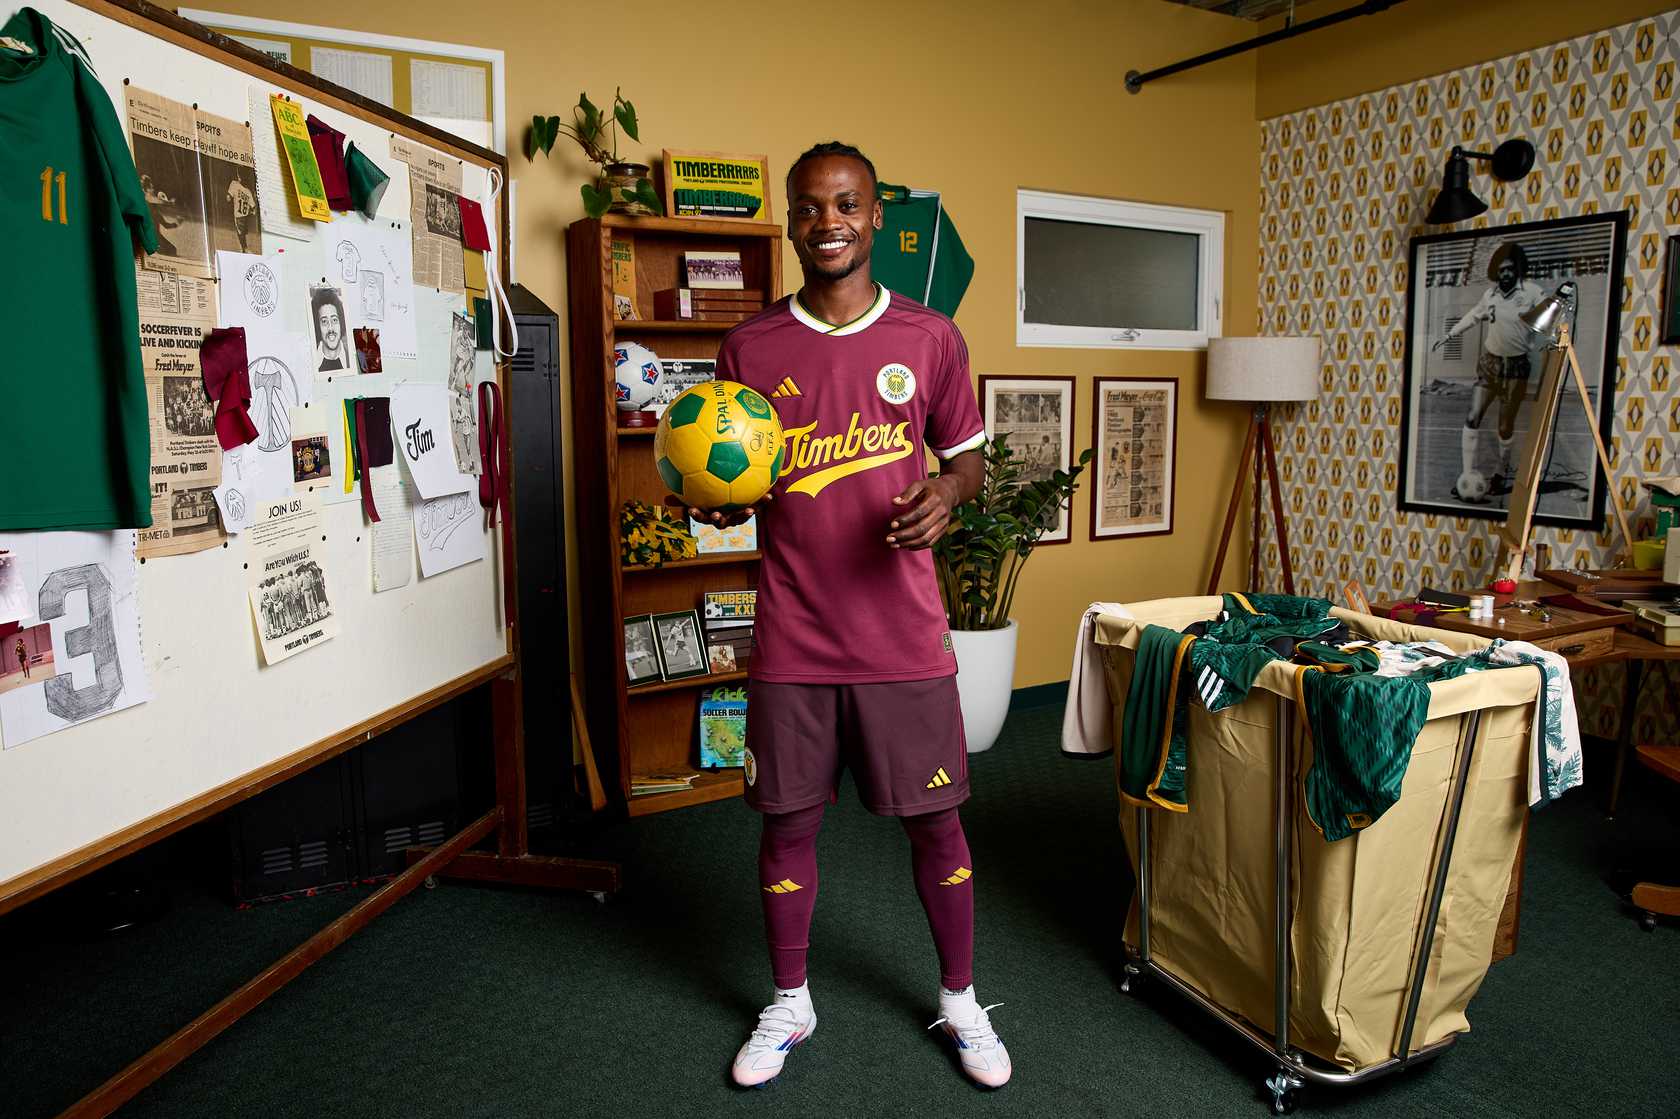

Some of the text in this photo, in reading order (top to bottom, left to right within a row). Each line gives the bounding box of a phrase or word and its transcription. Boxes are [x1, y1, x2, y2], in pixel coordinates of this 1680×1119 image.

[196, 120, 221, 137] SPORTS
[131, 116, 168, 140] Timbers
[169, 128, 191, 147] keep
[218, 144, 239, 160] hope
[240, 153, 255, 165] aliv
[40, 166, 68, 225] 11
[899, 230, 919, 253] 12
[141, 323, 202, 337] SOCCERFEVER IS
[140, 337, 201, 350] LIVE AND KICKIN
[155, 358, 195, 375] Fred Meyer
[883, 367, 910, 380] PORTLAND
[884, 389, 908, 401] TIMBERS
[712, 381, 736, 435] SPALDIN
[405, 417, 435, 461] Tim
[779, 412, 914, 478] Timbers
[152, 461, 208, 475] PORTLAND TIMBERS
[268, 499, 303, 519] JOIN US!
[139, 531, 164, 542] TRI-MET
[264, 561, 275, 572] Are
[706, 593, 757, 604] TIMBERS
[39, 563, 124, 722] 3
[702, 708, 728, 717] SOCCER
